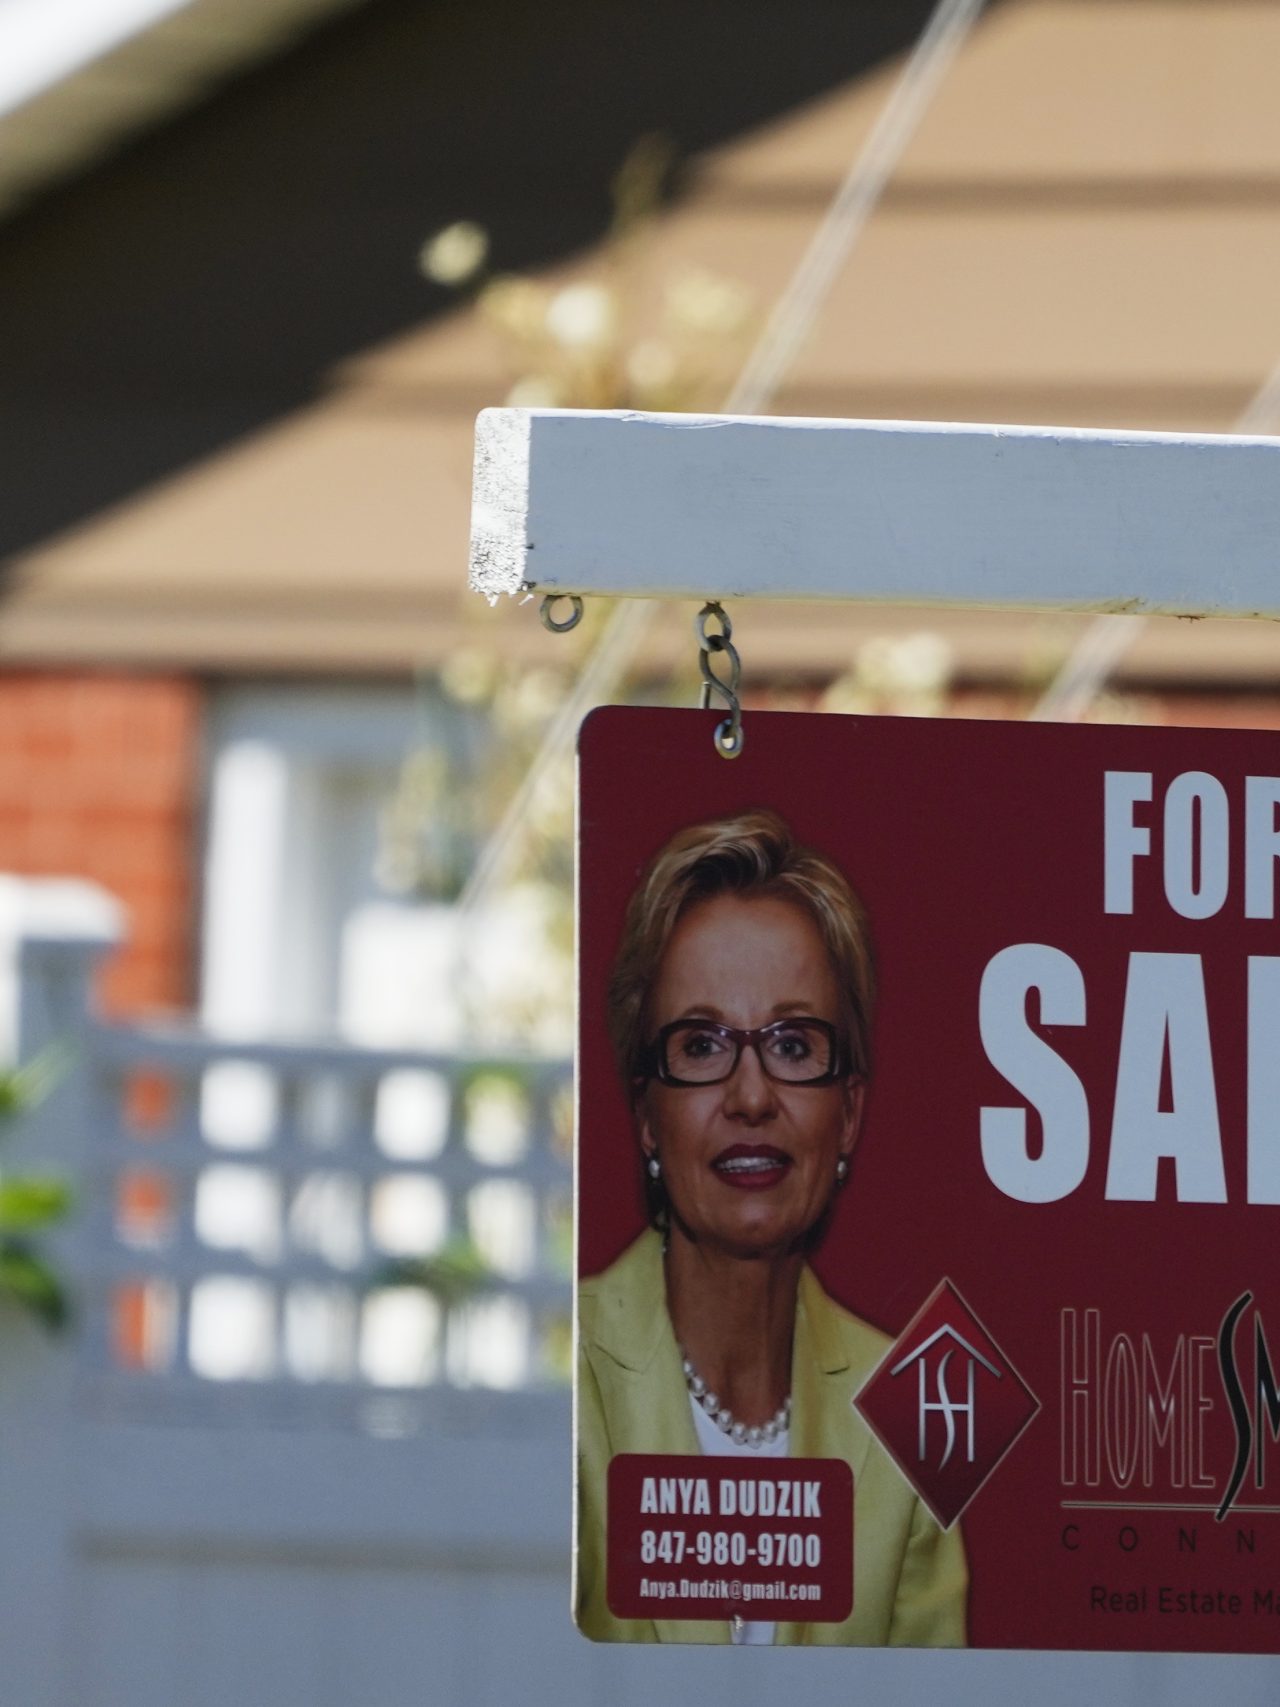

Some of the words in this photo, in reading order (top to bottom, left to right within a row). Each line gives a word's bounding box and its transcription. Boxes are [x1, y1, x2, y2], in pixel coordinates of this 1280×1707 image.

[640, 1477, 712, 1515] ANYA
[719, 1479, 822, 1518] DUDZIK
[640, 1530, 821, 1568] 847-980-9700
[639, 1578, 822, 1602] Anya.Dudzik@gmail.com
[1089, 1585, 1148, 1614] Real
[1158, 1586, 1243, 1616] Estate
